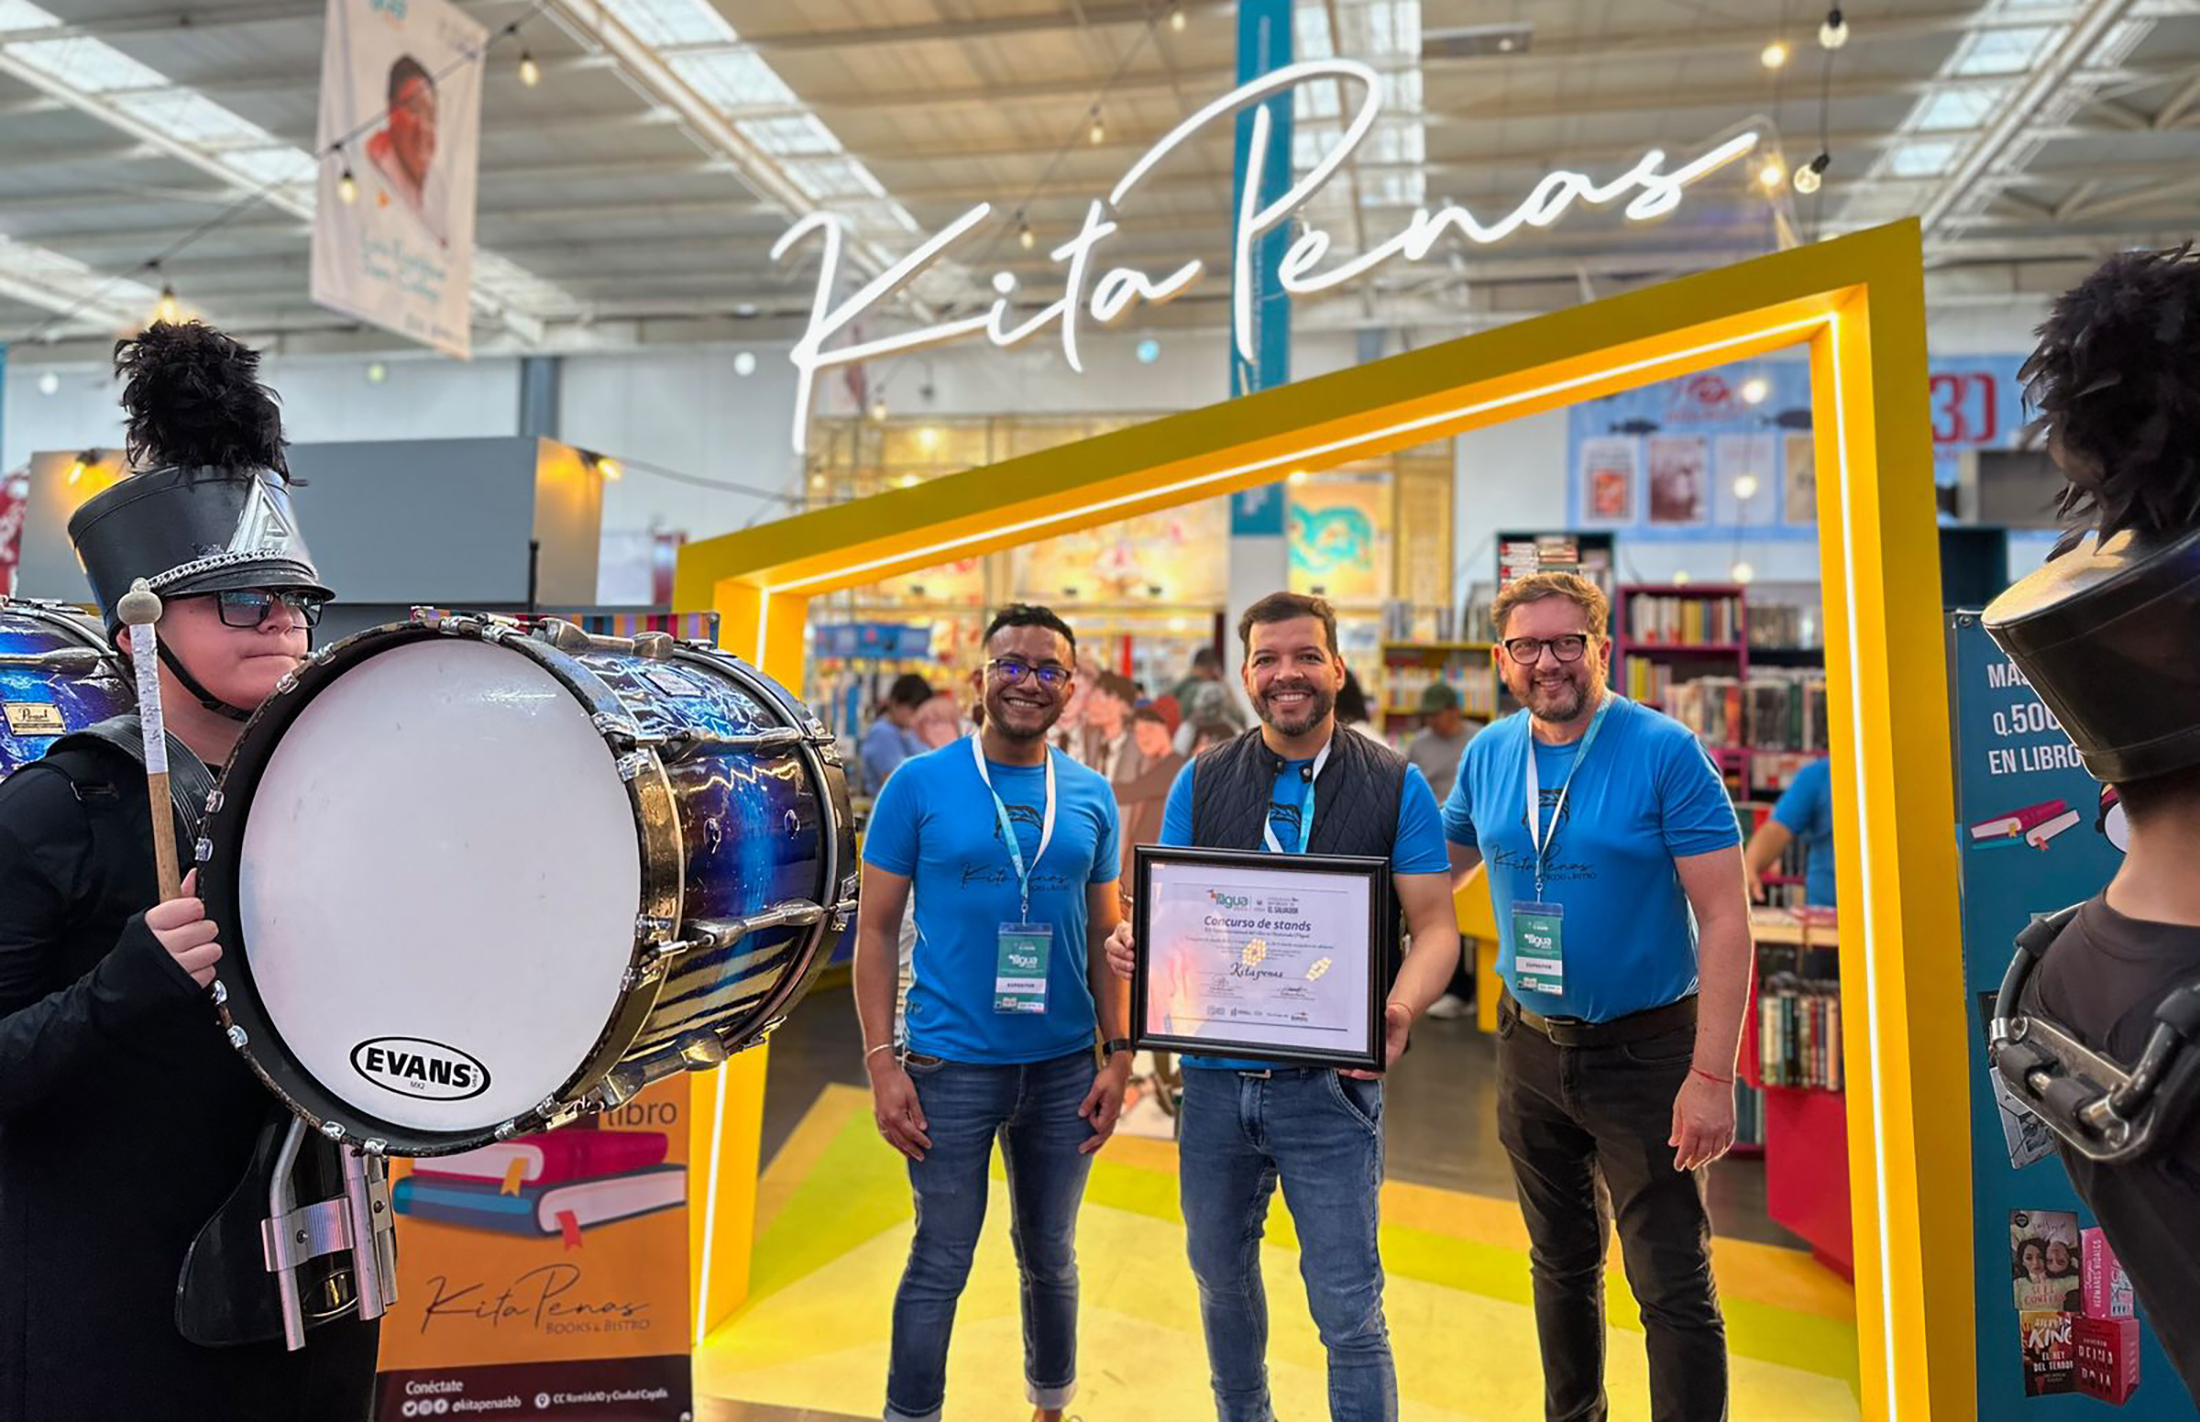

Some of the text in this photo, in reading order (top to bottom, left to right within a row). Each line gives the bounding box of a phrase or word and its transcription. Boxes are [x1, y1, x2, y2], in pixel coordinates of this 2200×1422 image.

[1988, 748, 2017, 775] EN
[1203, 915, 1255, 929] Concurso
[1257, 918, 1272, 929] de
[1273, 920, 1312, 932] stands
[365, 1046, 472, 1089] EVANS
[410, 1080, 425, 1090] MX2
[546, 1321, 592, 1335] BOOKS
[604, 1318, 650, 1333] BISTRO
[2034, 1361, 2047, 1372] DEL
[405, 1380, 464, 1396] Conéctate
[451, 1396, 522, 1413] @kitapenasbb
[553, 1394, 566, 1404] CC
